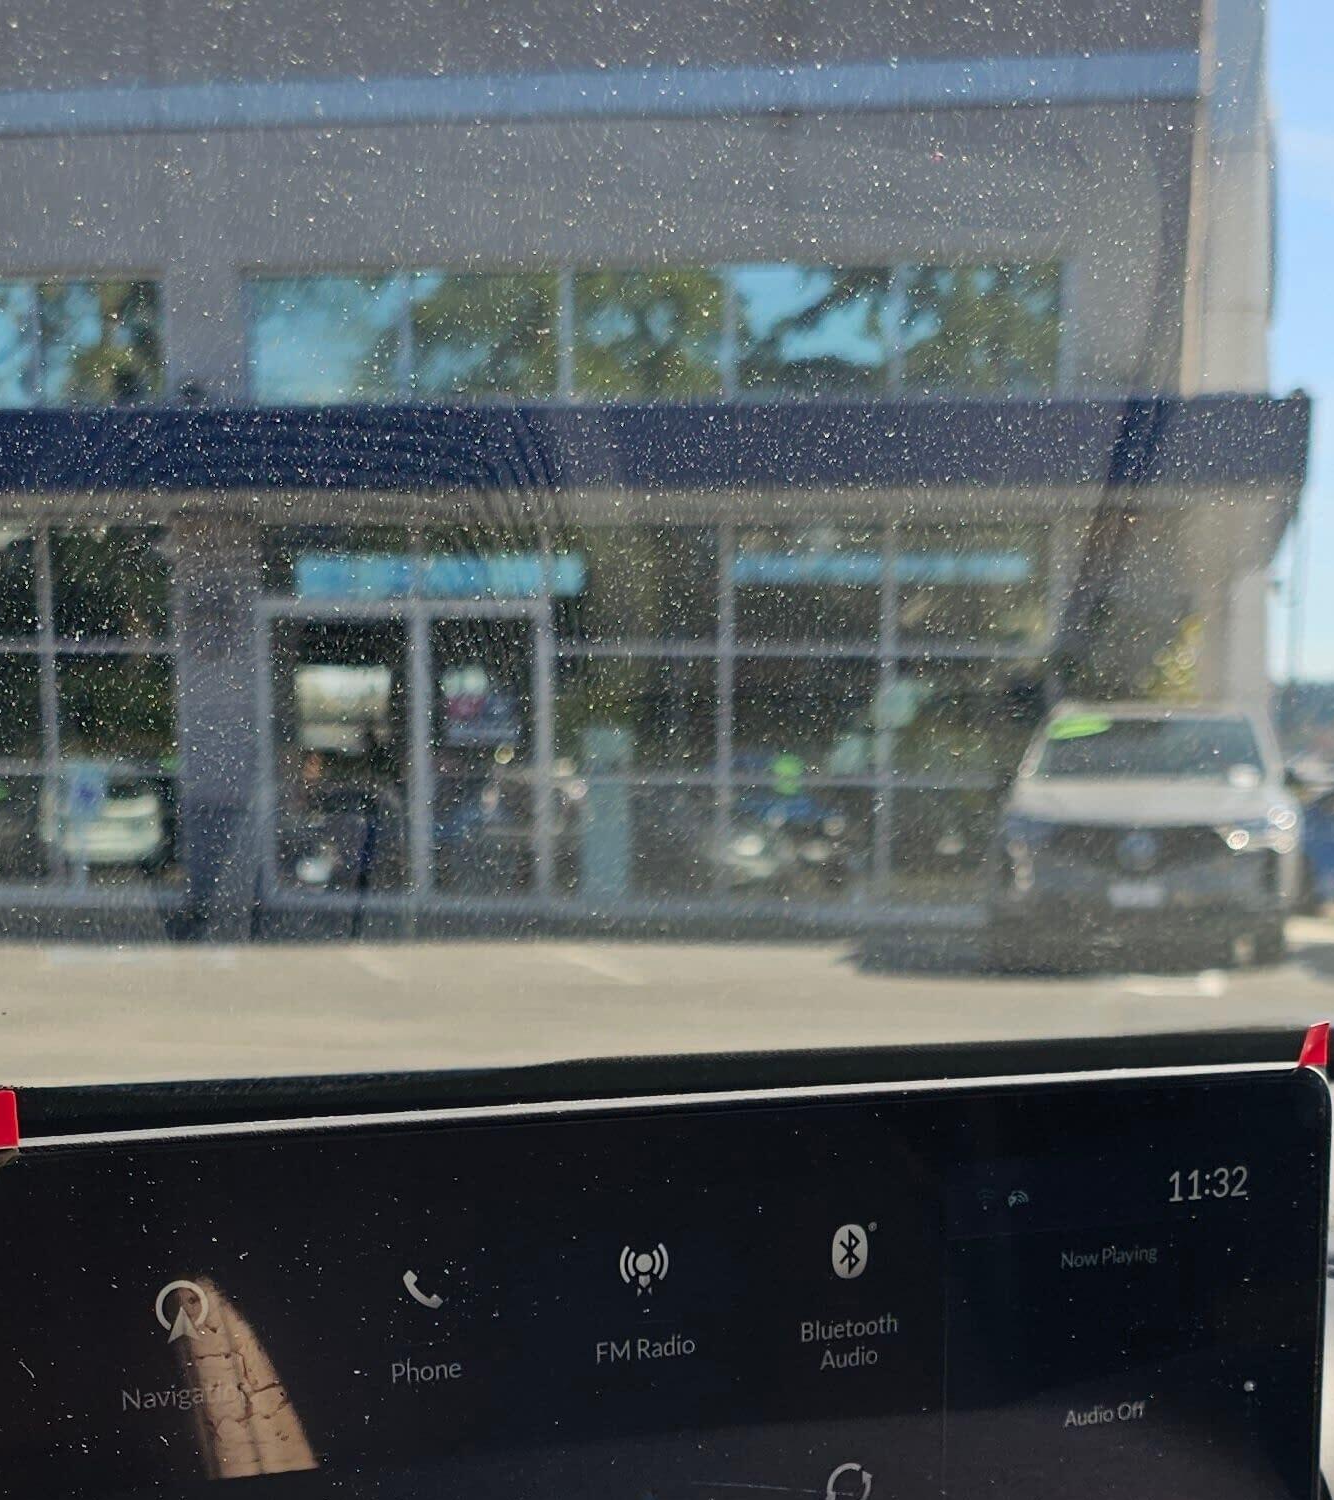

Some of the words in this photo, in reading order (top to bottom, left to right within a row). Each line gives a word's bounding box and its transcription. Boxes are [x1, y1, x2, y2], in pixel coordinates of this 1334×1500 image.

[1168, 1165, 1249, 1202] 11:32
[1060, 1251, 1098, 1270] Now
[1101, 1246, 1158, 1268] Playing
[800, 1311, 900, 1343] Bluetooth
[595, 1338, 631, 1365] FM
[636, 1333, 697, 1361] Radio
[819, 1345, 878, 1371] Audio
[391, 1357, 462, 1384] Phone
[120, 1382, 241, 1412] Naviga
[1064, 1404, 1114, 1427] Audio
[1117, 1401, 1146, 1421] Off
